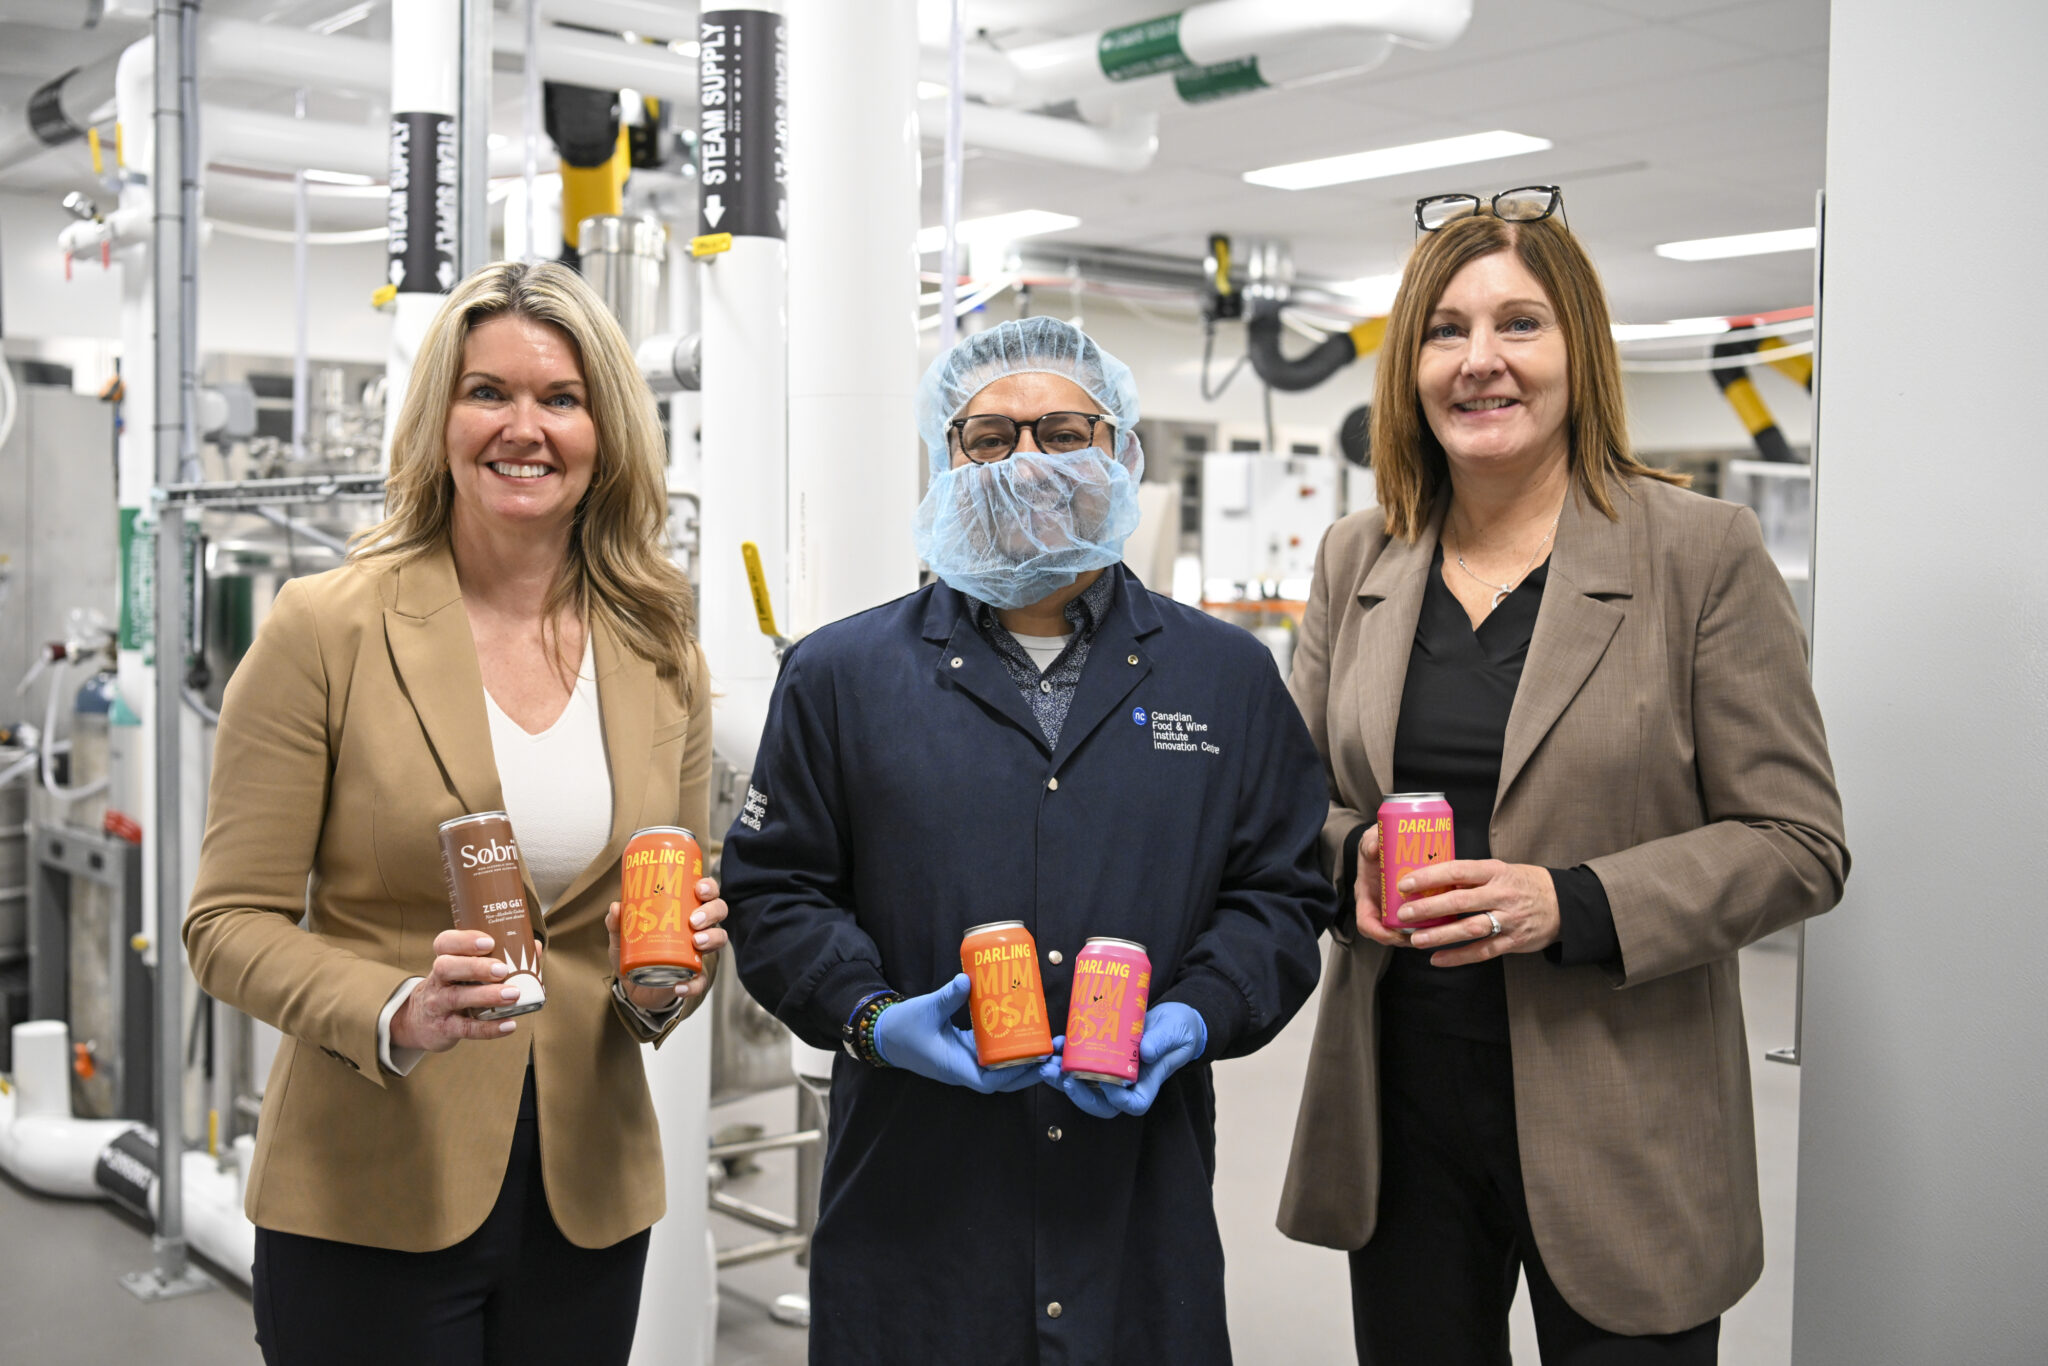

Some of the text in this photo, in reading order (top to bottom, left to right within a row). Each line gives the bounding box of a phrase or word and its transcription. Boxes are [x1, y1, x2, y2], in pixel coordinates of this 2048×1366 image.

[701, 23, 727, 186] STEAM SUPPLY
[388, 121, 410, 255] STEAM SUPPLY
[1151, 711, 1192, 722] Canadian
[1152, 721, 1208, 732] Food & Wine
[1153, 730, 1189, 741] Institute
[1153, 740, 1198, 752] Innovation
[1398, 817, 1451, 834] DARLING
[626, 849, 685, 871] DARLING
[1395, 831, 1451, 865] MIM
[623, 865, 683, 903] MIM
[622, 898, 681, 933] OSA
[974, 943, 1031, 966] DARLING
[1076, 959, 1130, 978] DARLING
[976, 959, 1035, 999] MIM
[1073, 974, 1127, 1010] MIM
[979, 992, 1040, 1032] OSA
[1068, 1007, 1121, 1043] OSA
